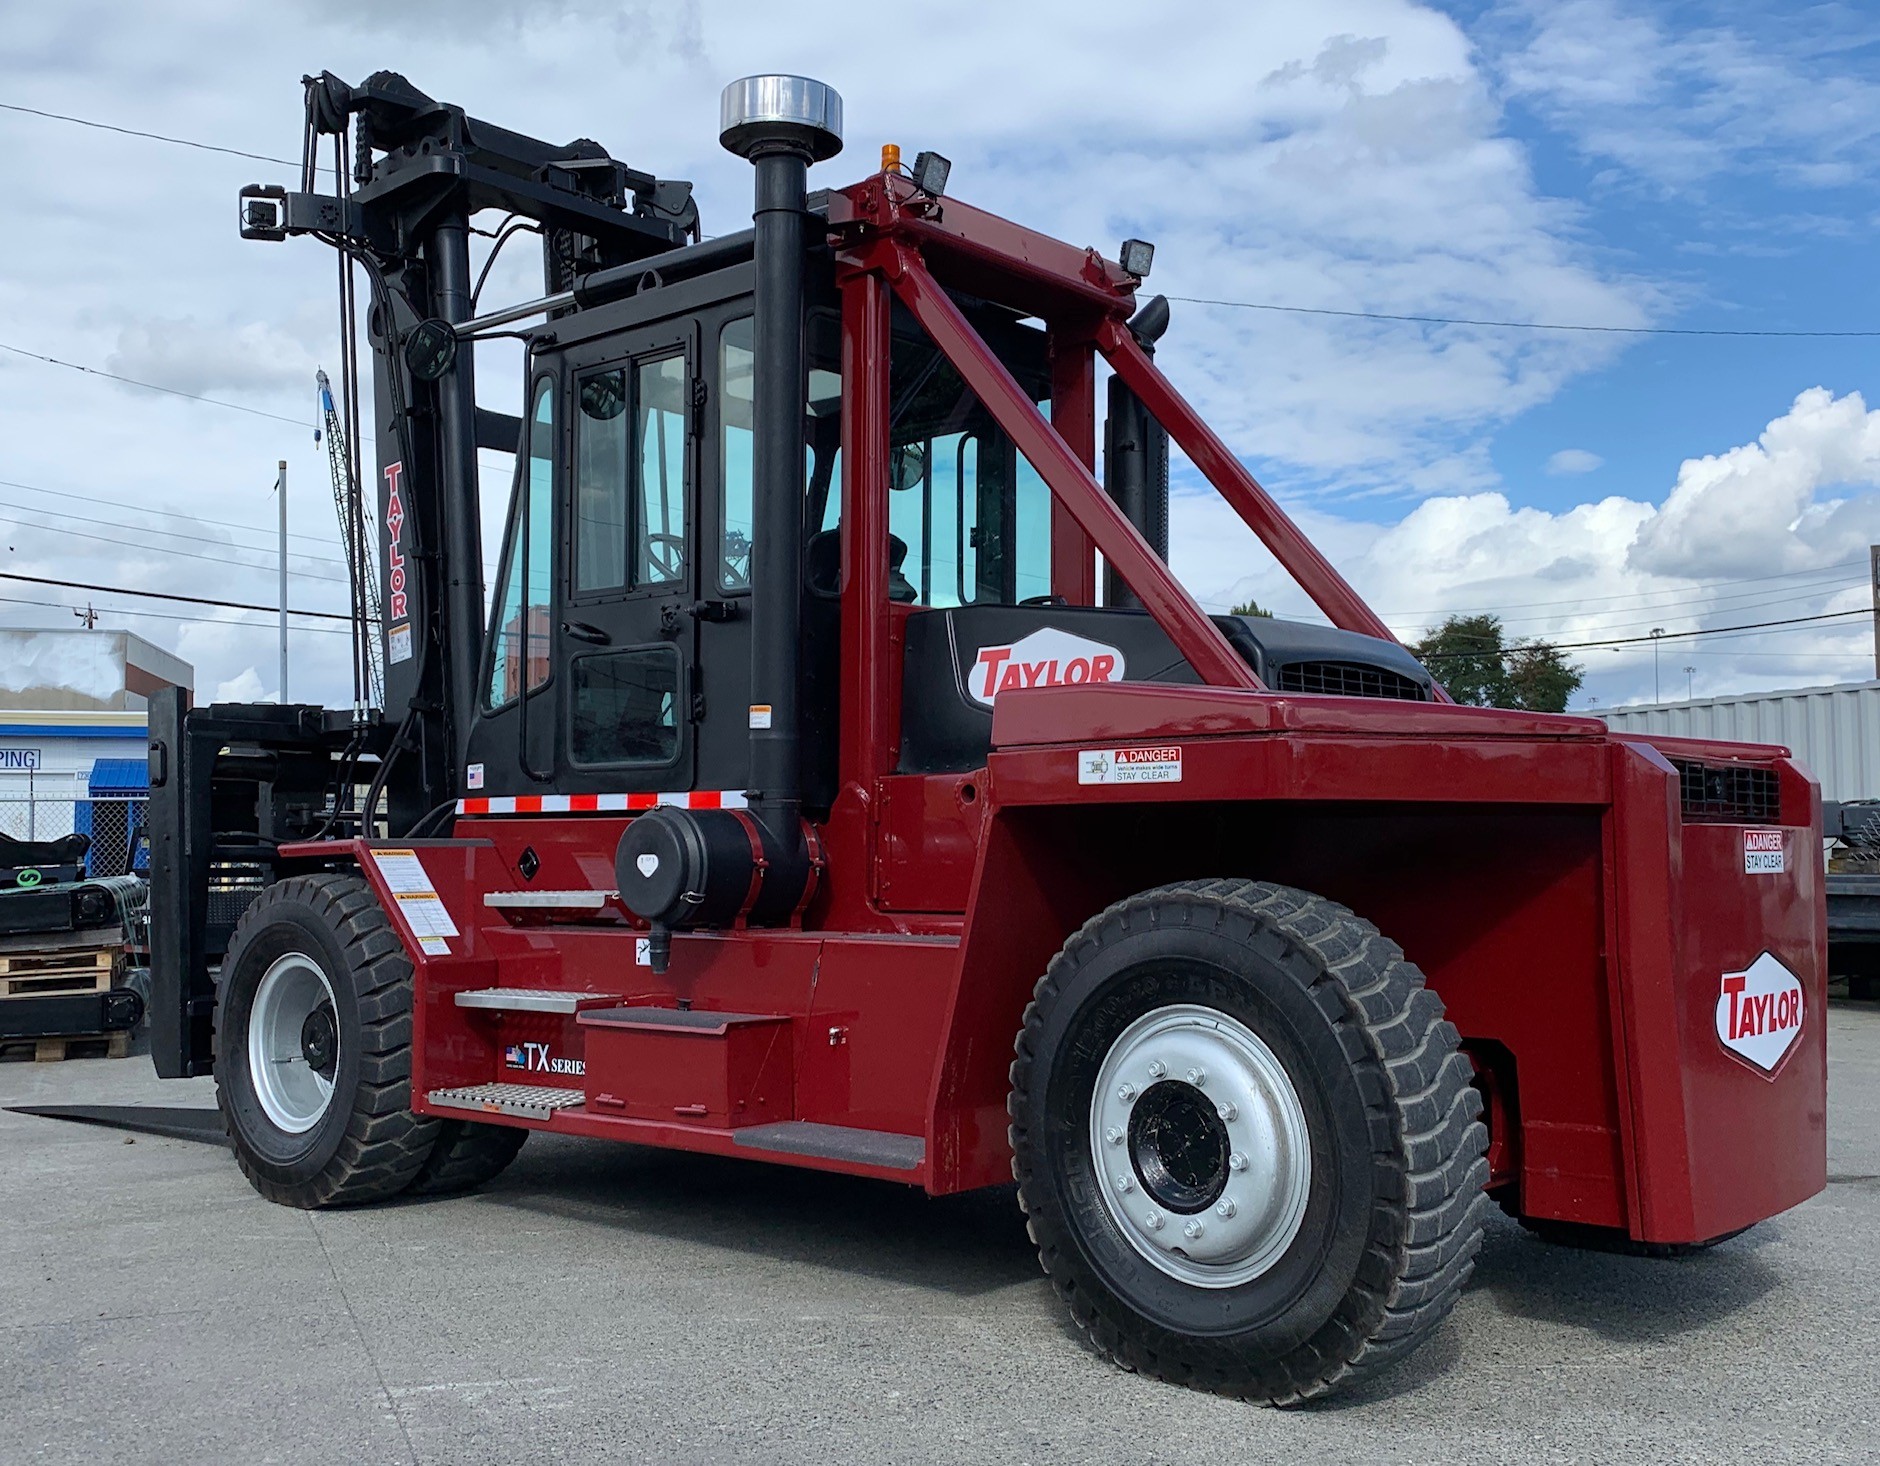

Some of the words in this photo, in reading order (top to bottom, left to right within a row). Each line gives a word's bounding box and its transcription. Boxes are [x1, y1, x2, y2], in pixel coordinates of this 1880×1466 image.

[384, 461, 408, 621] TAYLOR
[979, 648, 1115, 698] TAYLOR
[1129, 749, 1177, 762] DANGER
[1117, 772, 1137, 781] STAY
[1141, 771, 1170, 780] CLEAR
[1752, 834, 1782, 850] DANGER
[1747, 855, 1762, 869] STAY
[1763, 855, 1783, 868] CLEAR
[1723, 976, 1799, 1040] TAYLOR
[523, 1042, 550, 1072] TX
